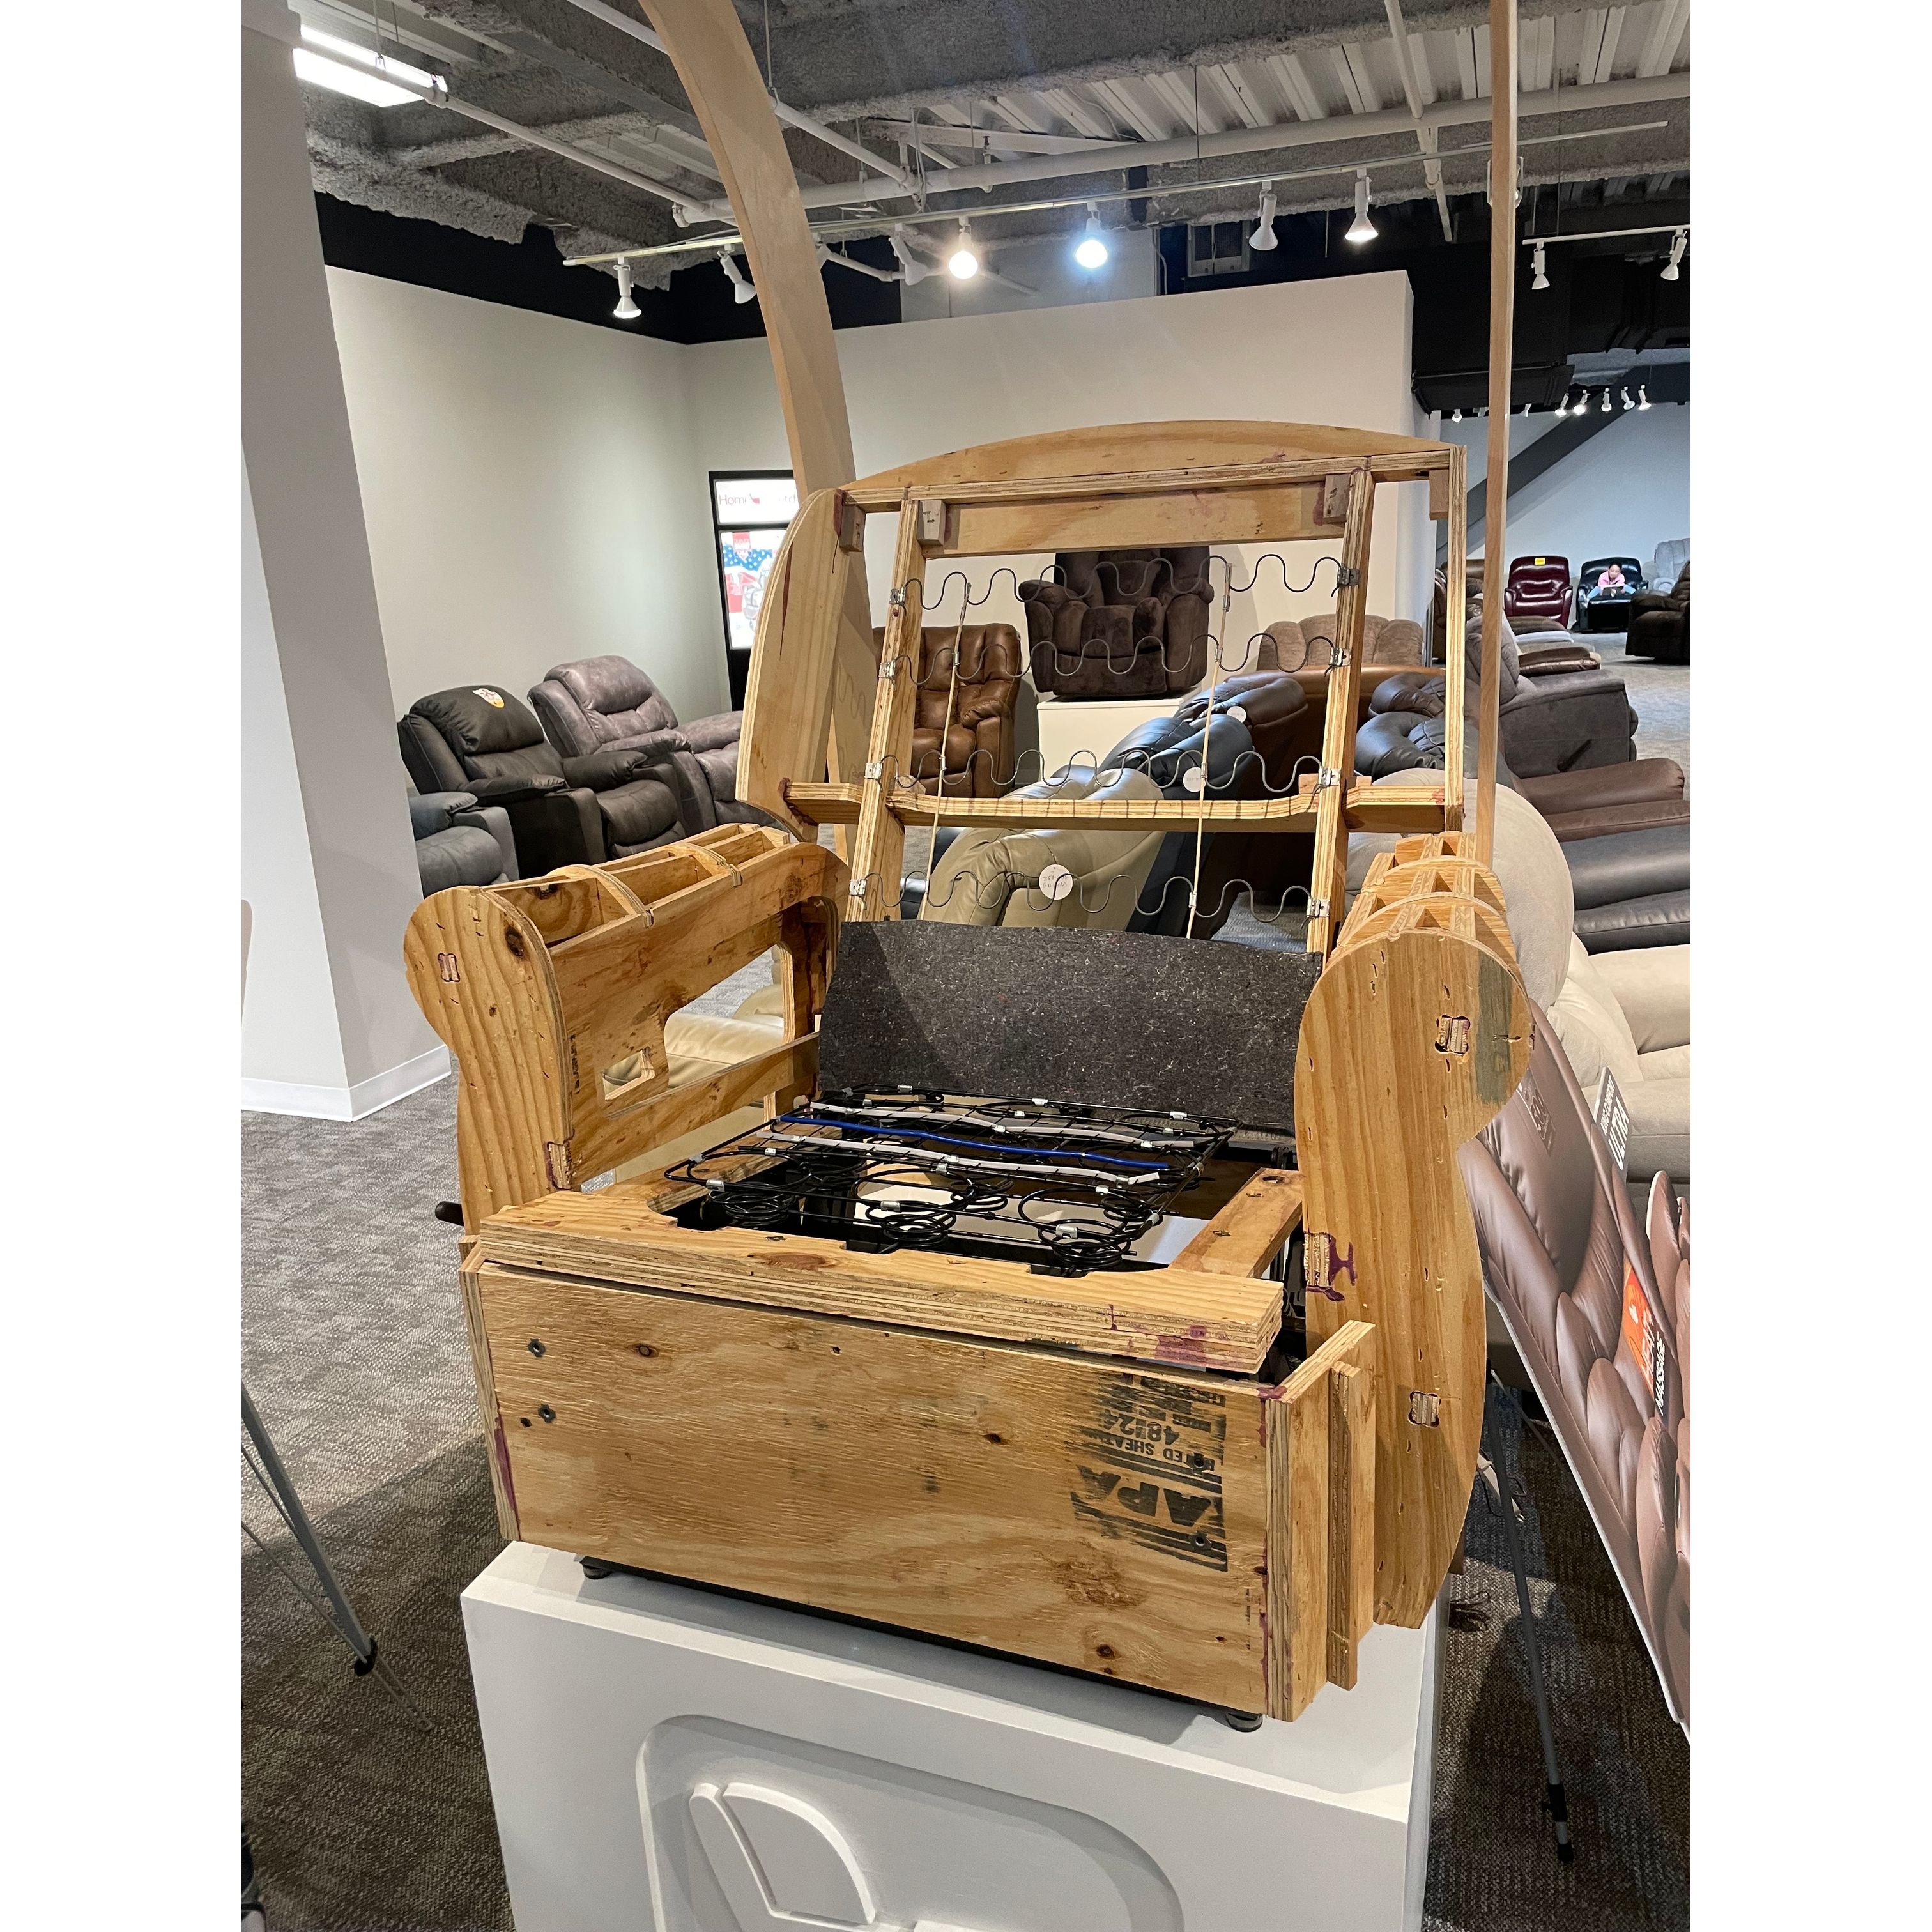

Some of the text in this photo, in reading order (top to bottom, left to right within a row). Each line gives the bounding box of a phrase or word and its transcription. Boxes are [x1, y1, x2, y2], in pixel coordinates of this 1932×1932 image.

[1608, 1096, 1630, 1170] ULTRA
[1655, 1331, 1666, 1416] MASSAGE
[1076, 1464, 1212, 1527] APA
